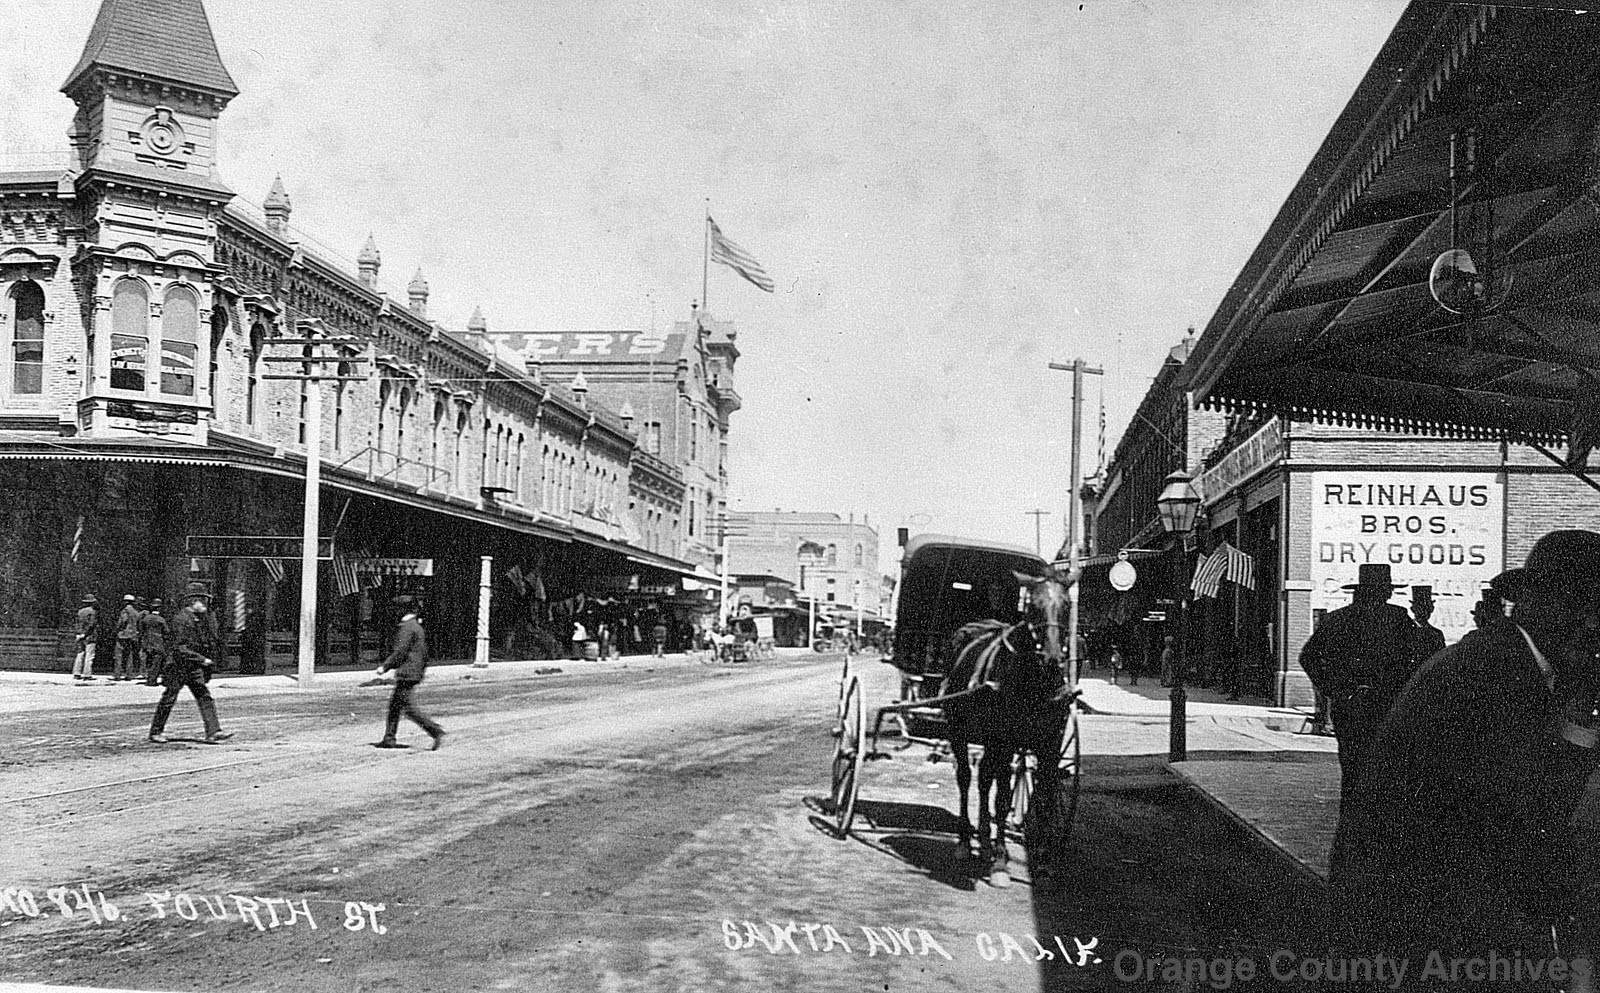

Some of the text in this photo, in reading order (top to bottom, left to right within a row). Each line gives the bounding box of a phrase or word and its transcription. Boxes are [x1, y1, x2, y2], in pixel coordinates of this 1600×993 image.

[1324, 484, 1488, 506] REINHAUS
[1361, 515, 1456, 534] BROS.
[1319, 542, 1486, 565] DRY GOODS
[145, 890, 317, 932] FOURTH
[343, 900, 388, 934] ST.
[721, 919, 852, 954] SANTA
[860, 925, 953, 961] ANA
